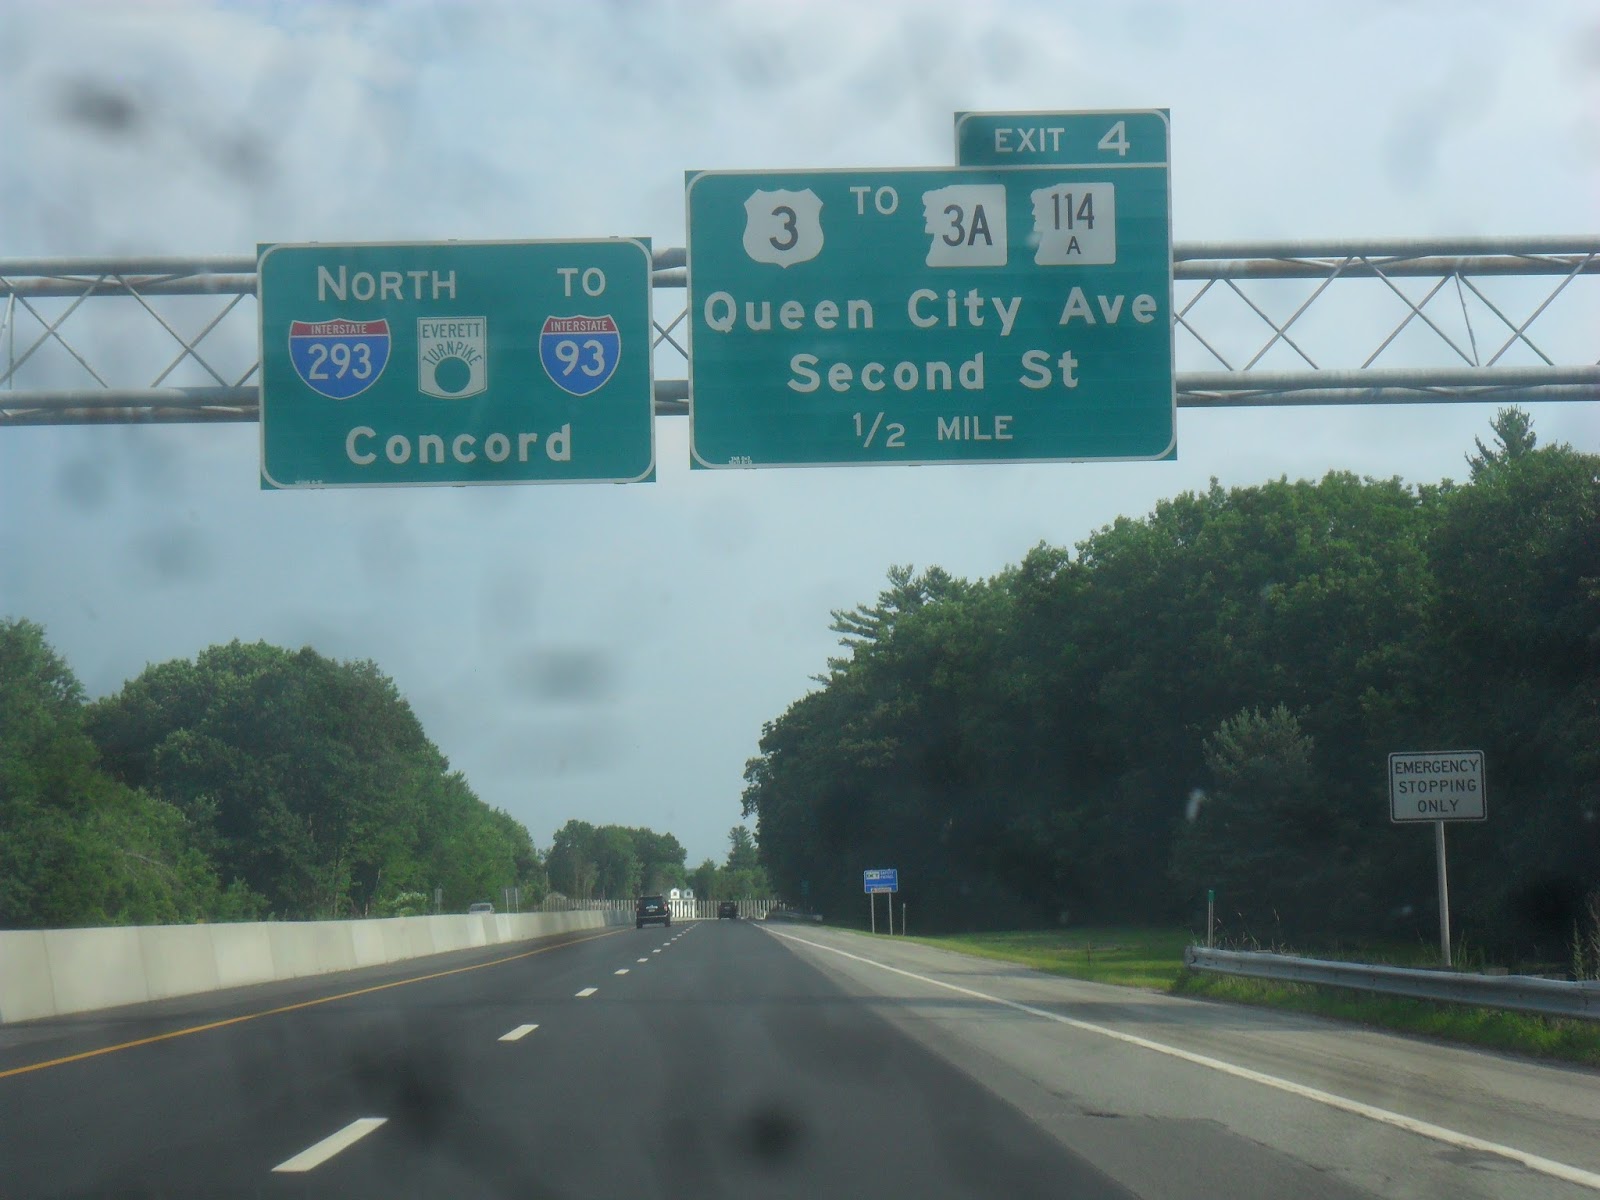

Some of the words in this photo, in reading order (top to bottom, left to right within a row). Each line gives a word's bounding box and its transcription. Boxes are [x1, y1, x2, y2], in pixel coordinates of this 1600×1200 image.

[994, 127, 1065, 153] EXIT
[1097, 120, 1130, 156] 4
[849, 186, 899, 215] TO
[1051, 192, 1095, 230] 114
[769, 205, 799, 251] 3
[942, 204, 993, 247] 3A
[1066, 235, 1081, 255] A
[317, 265, 456, 301] NORTH
[557, 267, 606, 297] TO
[311, 322, 367, 335] INTERSTATE
[550, 318, 608, 332] INTERSTATE
[704, 290, 874, 334] Queen
[907, 287, 1022, 336] City
[1059, 286, 1157, 325] Ave
[421, 322, 481, 339] EVERETT
[308, 342, 372, 380] 293
[421, 341, 483, 366] TURNPIKE
[555, 339, 605, 377] 93
[787, 351, 985, 394] Second
[1018, 349, 1079, 389] St
[345, 422, 572, 465] Concord
[853, 411, 906, 448] 1/2
[937, 415, 1013, 441] MILE
[1395, 759, 1479, 774] EMERGENCY
[1399, 779, 1477, 794] STOPPING
[1417, 799, 1459, 813] ONLY
